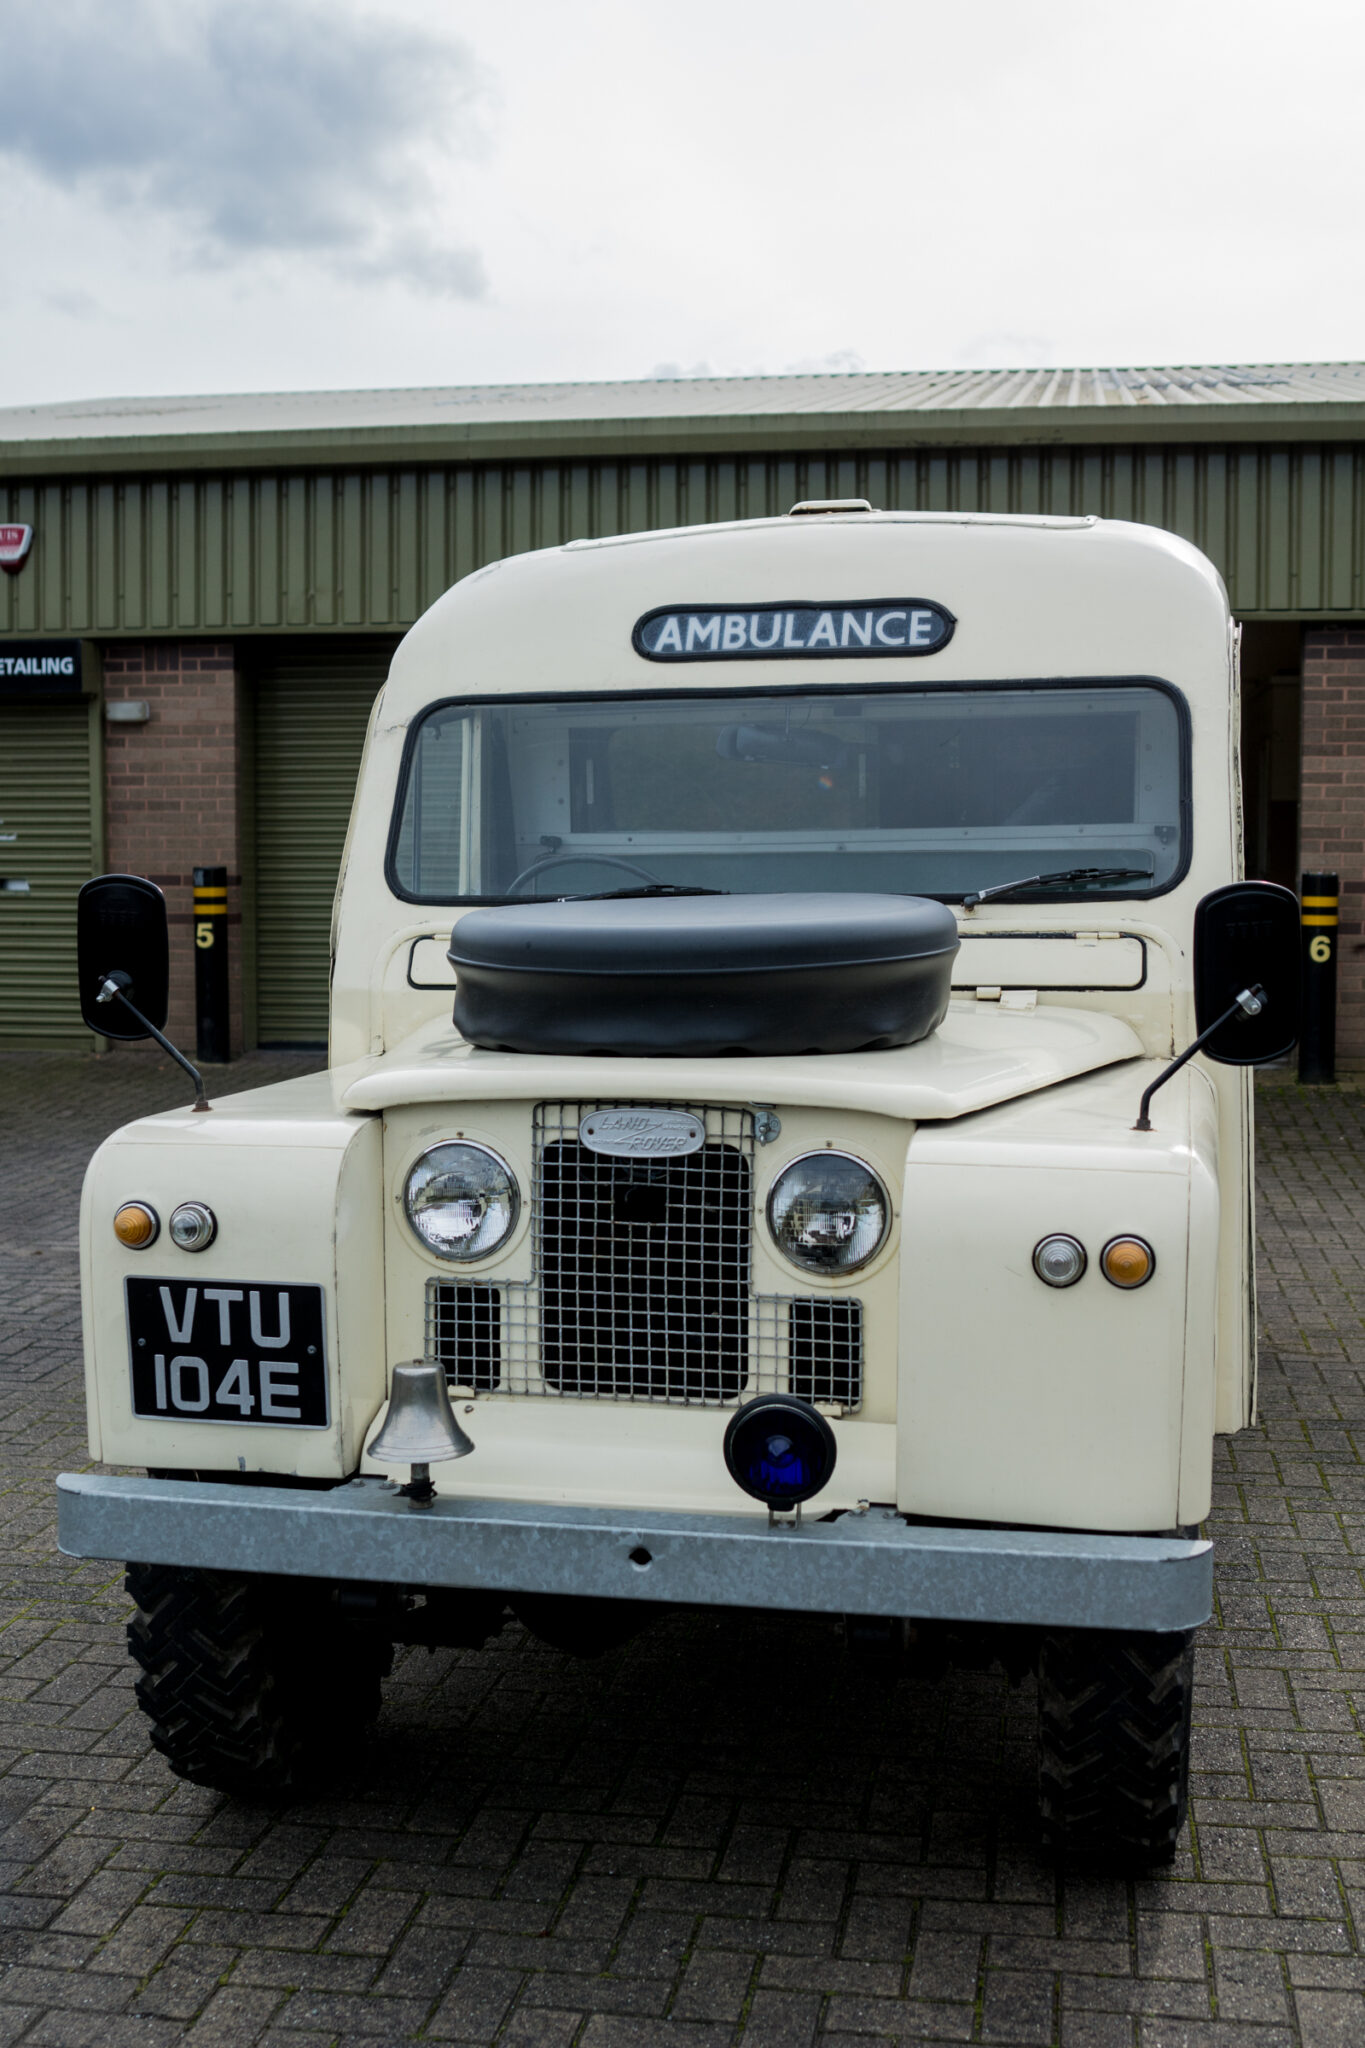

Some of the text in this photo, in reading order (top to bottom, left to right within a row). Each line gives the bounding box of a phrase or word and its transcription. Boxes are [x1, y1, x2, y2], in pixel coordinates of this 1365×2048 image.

[654, 611, 932, 651] AMBULANCE
[196, 922, 215, 949] 5
[1310, 935, 1331, 963] 6
[599, 1117, 652, 1131] LAND
[629, 1136, 688, 1152] ROVER
[158, 1286, 291, 1348] VTU
[154, 1354, 301, 1418] 104E
